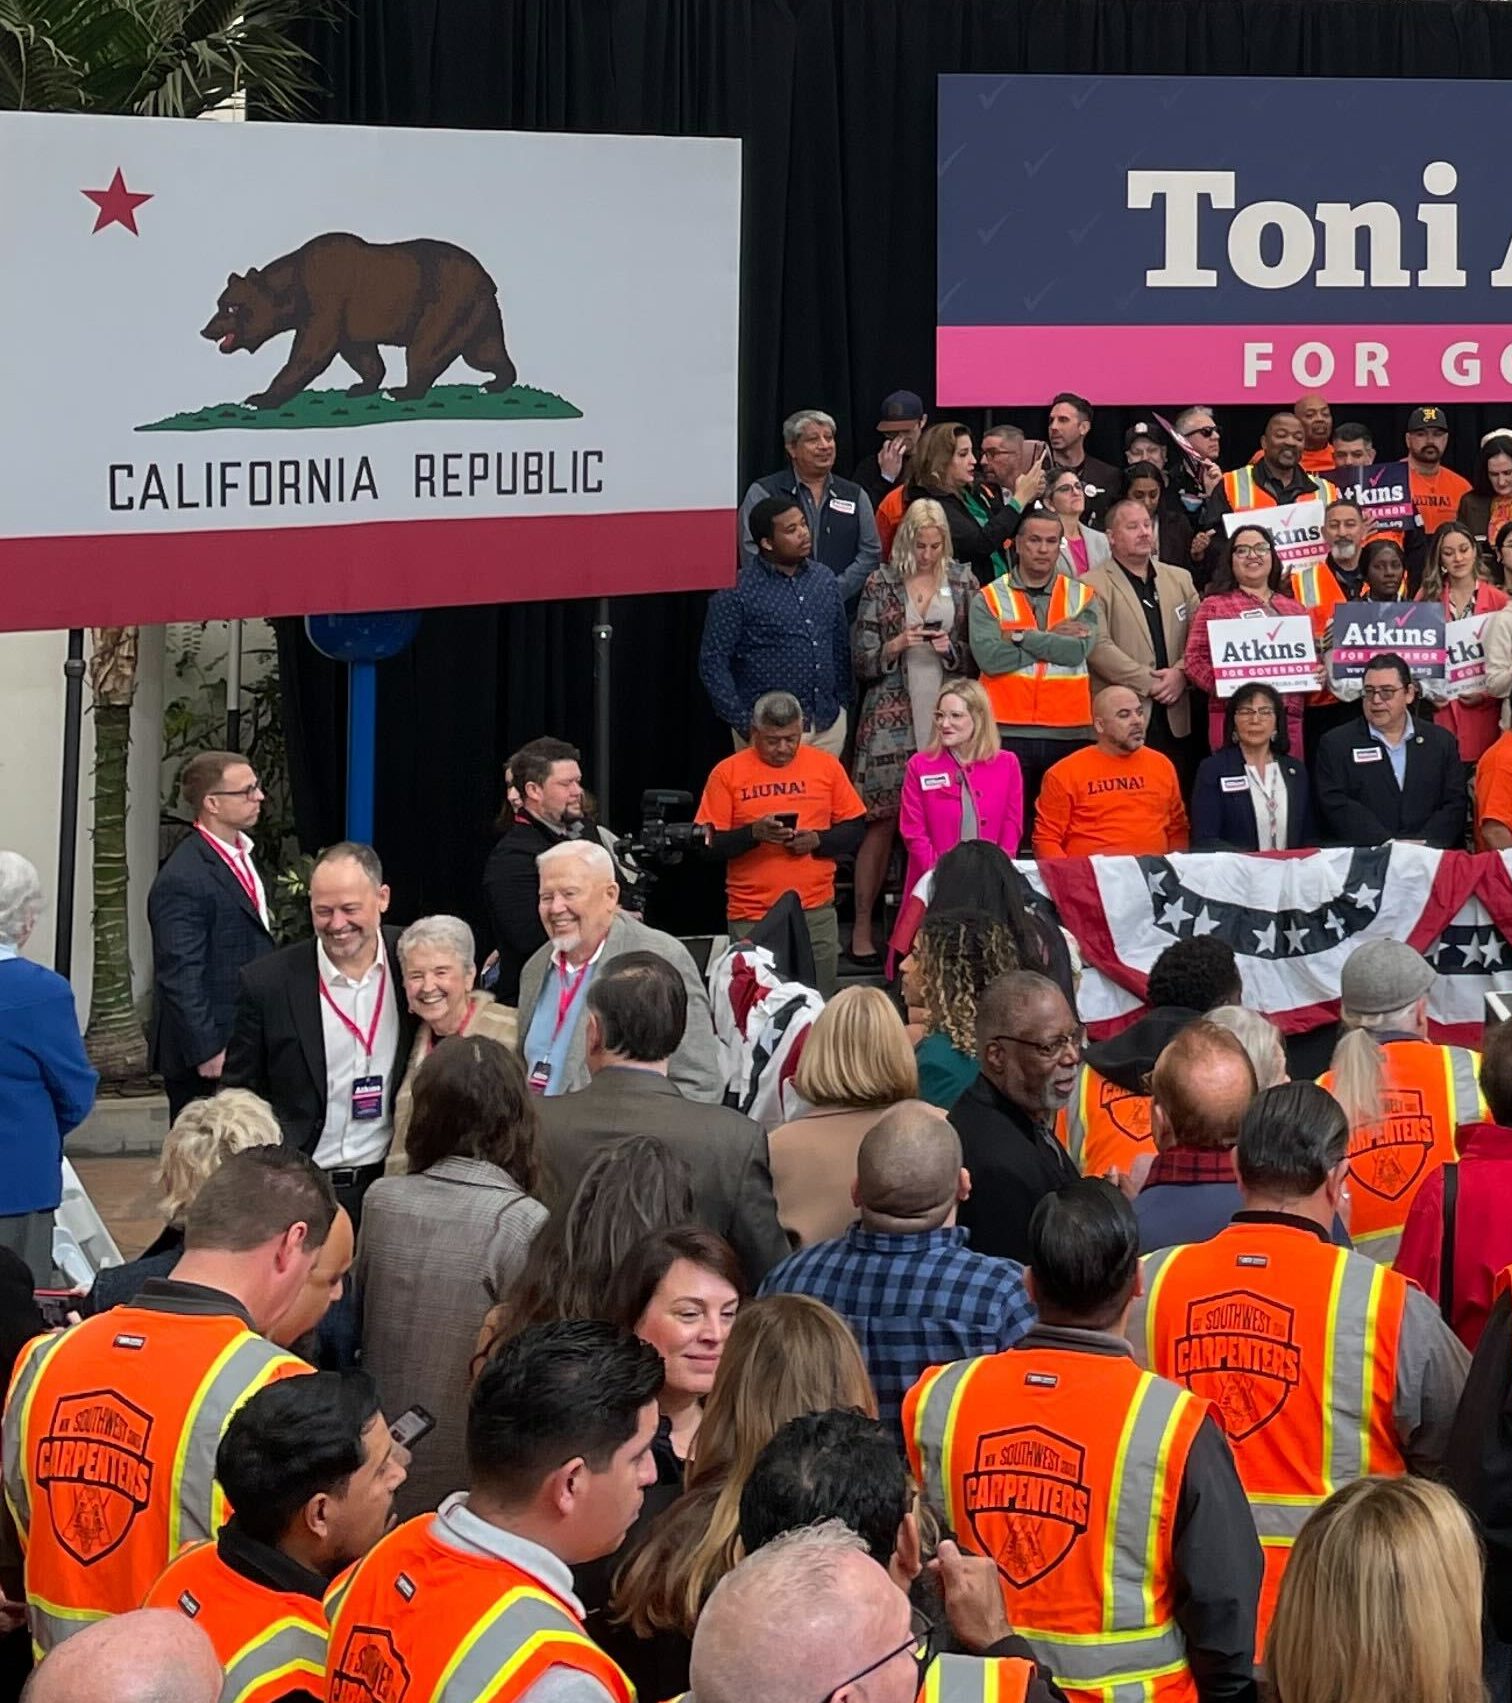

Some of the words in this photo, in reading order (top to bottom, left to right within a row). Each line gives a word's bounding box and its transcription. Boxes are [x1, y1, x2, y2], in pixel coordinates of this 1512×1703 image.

[1127, 161, 1467, 289] Toni
[1243, 341, 1391, 388] FOR
[108, 455, 380, 511] CALIFORNIA
[413, 450, 604, 499] REPUBLIC
[1267, 525, 1321, 547] kins
[1221, 639, 1307, 663] Atkins
[1341, 621, 1437, 647] Atkins
[1222, 666, 1249, 678] FOR
[1249, 663, 1312, 677] GOVERNOR
[1340, 651, 1364, 661] FOR
[1205, 1303, 1272, 1333] SOUTHWEST
[1176, 1336, 1299, 1384] CARPENTERS
[72, 1405, 129, 1441] SOUTHWEST
[38, 1440, 151, 1503] CARPENTERS
[999, 1439, 1060, 1472] SOUTHWEST
[965, 1474, 1088, 1527] CARPENTERS
